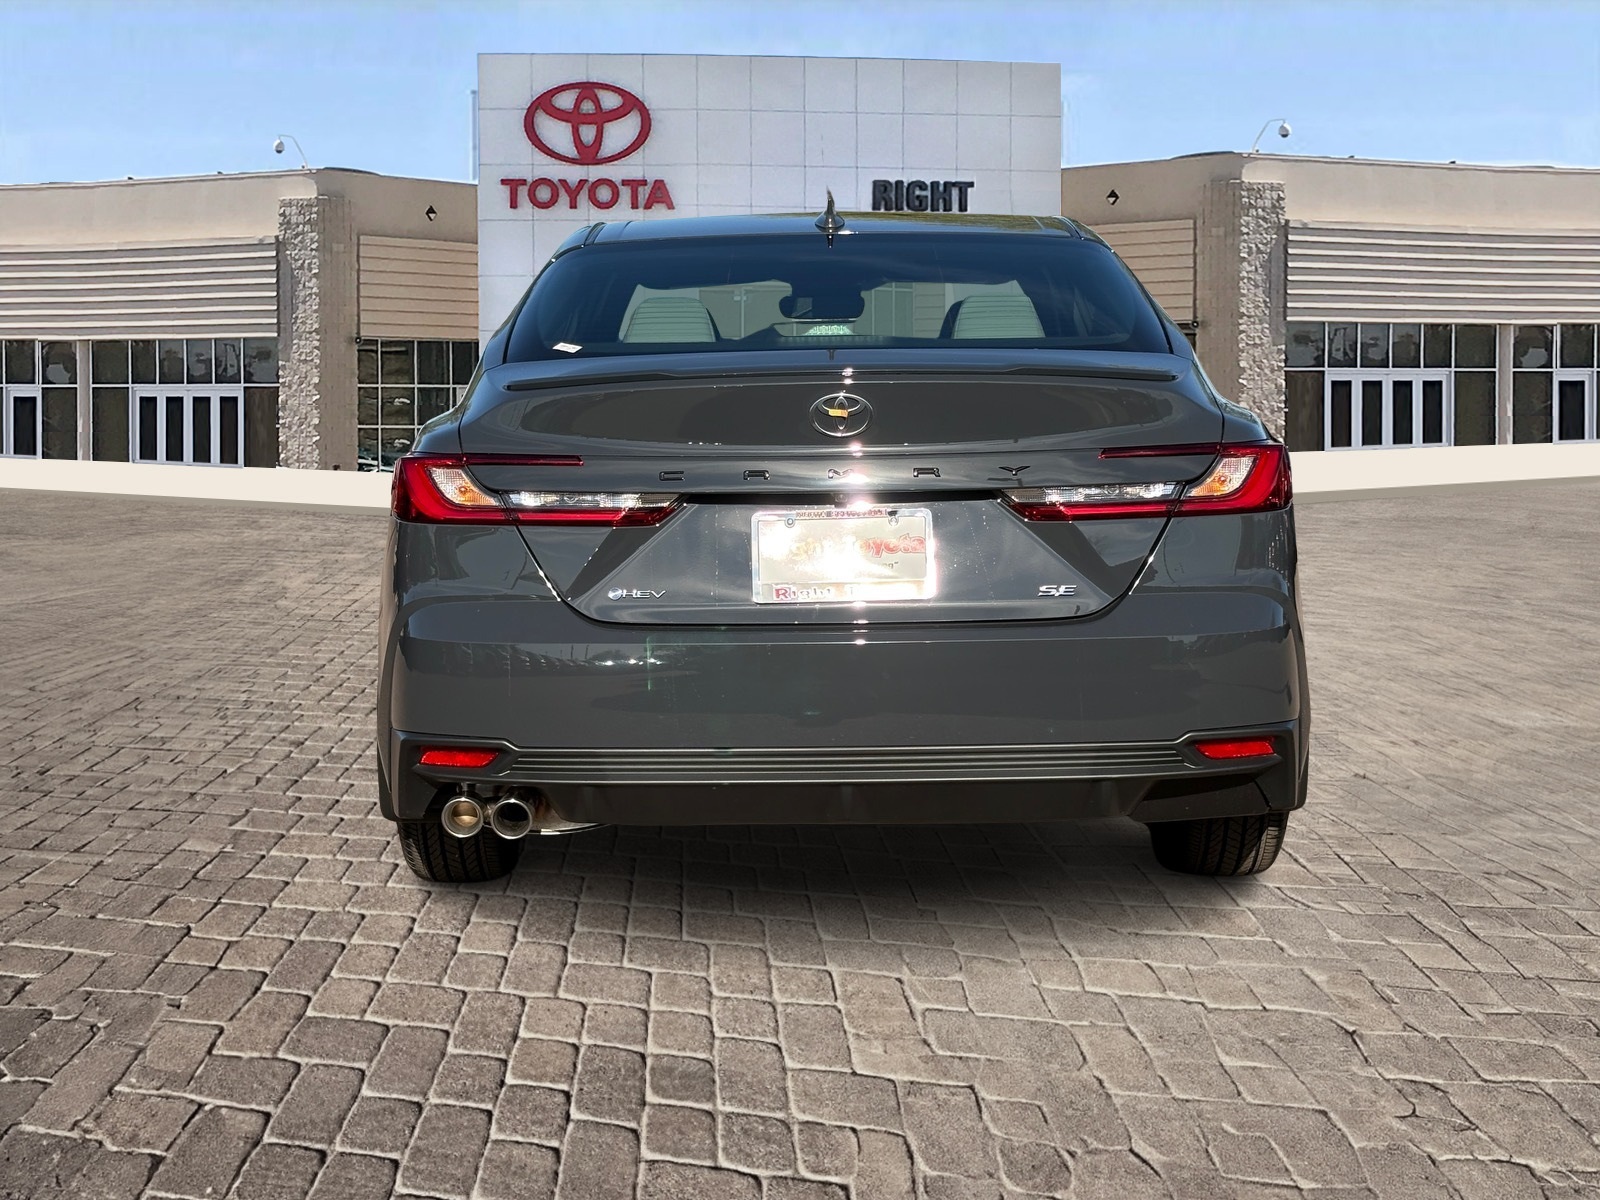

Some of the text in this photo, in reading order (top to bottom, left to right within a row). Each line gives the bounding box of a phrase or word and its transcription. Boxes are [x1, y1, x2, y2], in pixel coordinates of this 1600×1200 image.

[500, 178, 675, 210] TOYOTA
[872, 179, 975, 212] RIGHT
[658, 465, 1031, 482] CAMRY
[1037, 585, 1077, 597] SE
